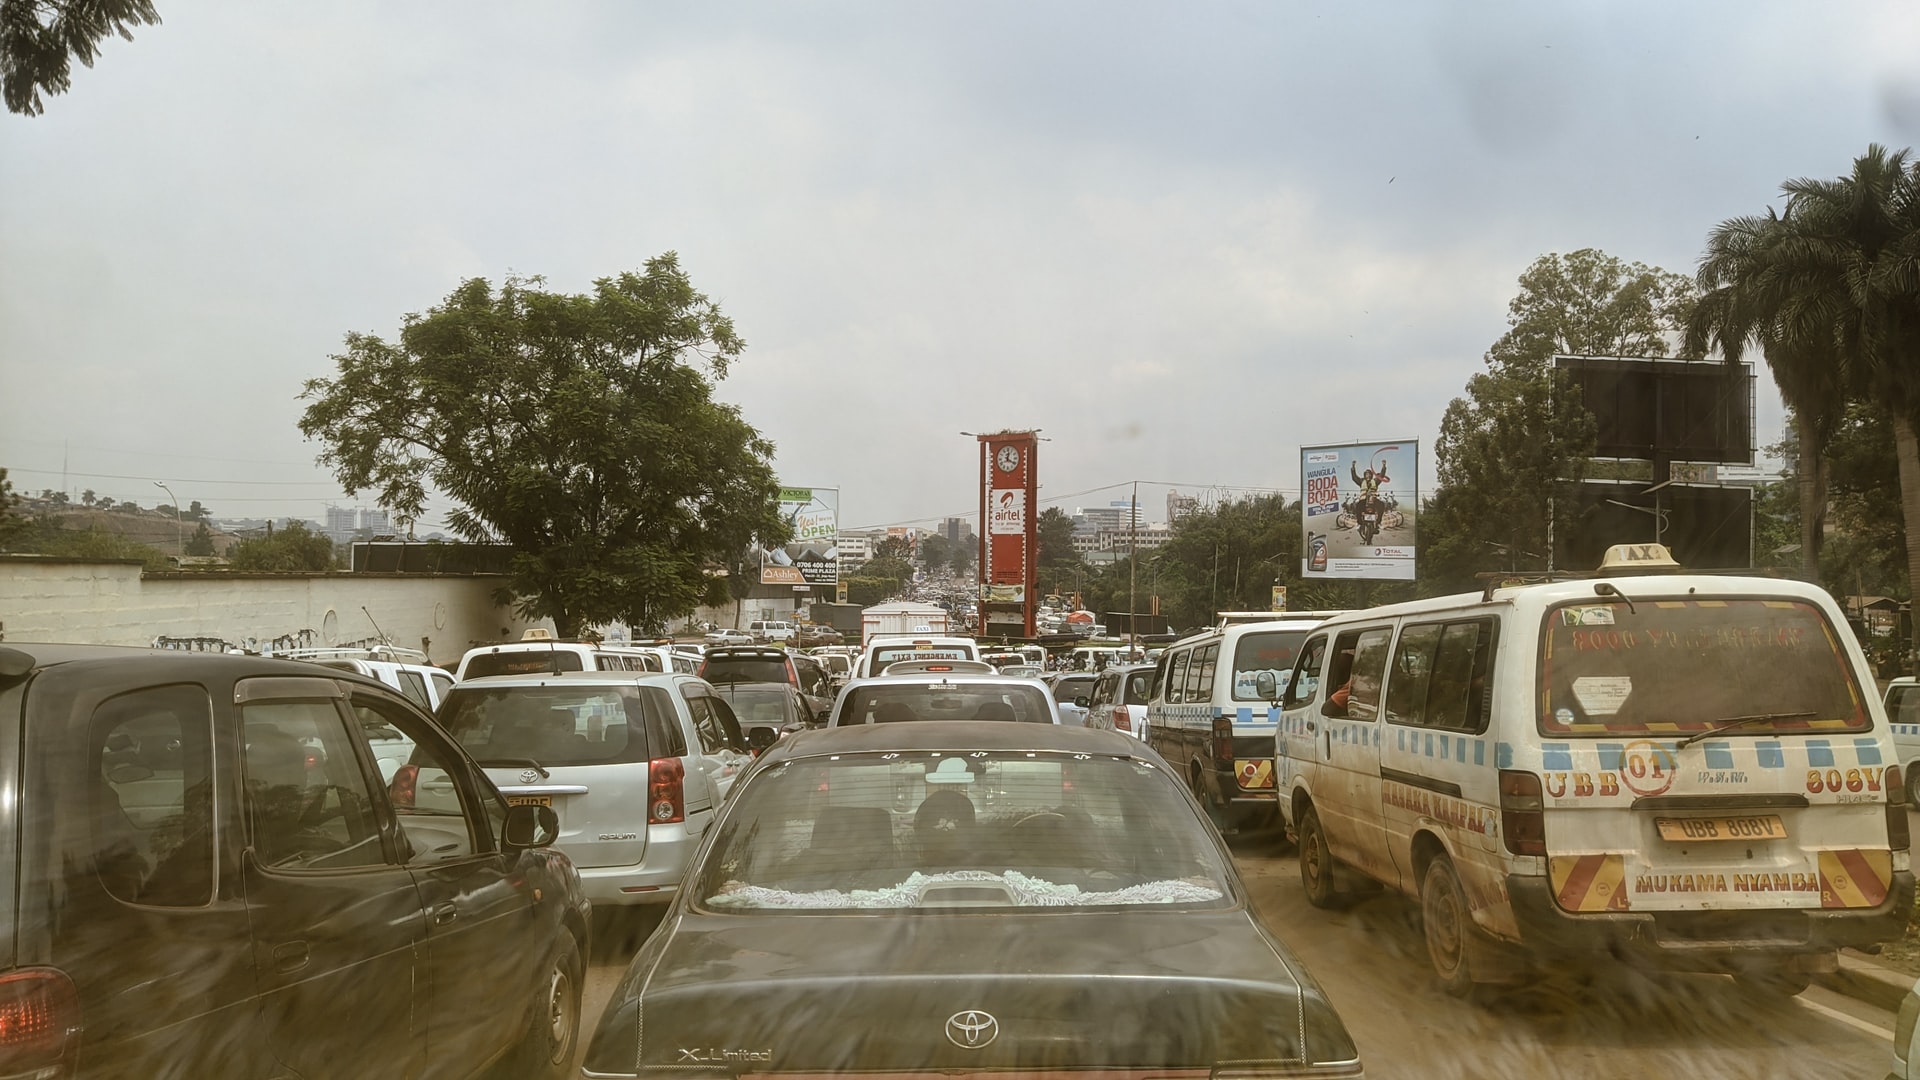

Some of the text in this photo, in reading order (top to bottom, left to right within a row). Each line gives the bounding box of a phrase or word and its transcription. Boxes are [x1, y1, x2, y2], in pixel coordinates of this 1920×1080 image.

[1307, 468, 1336, 478] WANGULA
[1307, 475, 1338, 491] BODA
[1307, 489, 1338, 504] BODA
[797, 514, 818, 528] Yes!
[995, 509, 1020, 521] airtel
[801, 523, 835, 538] OPEN
[773, 570, 798, 579] Ashley
[1628, 754, 1665, 779] 01
[1543, 772, 1619, 798] UBB
[1806, 767, 1883, 794] 808V
[1679, 817, 1773, 839] UBB 808V
[1635, 872, 1819, 893] MUKAMA NYAMBA
